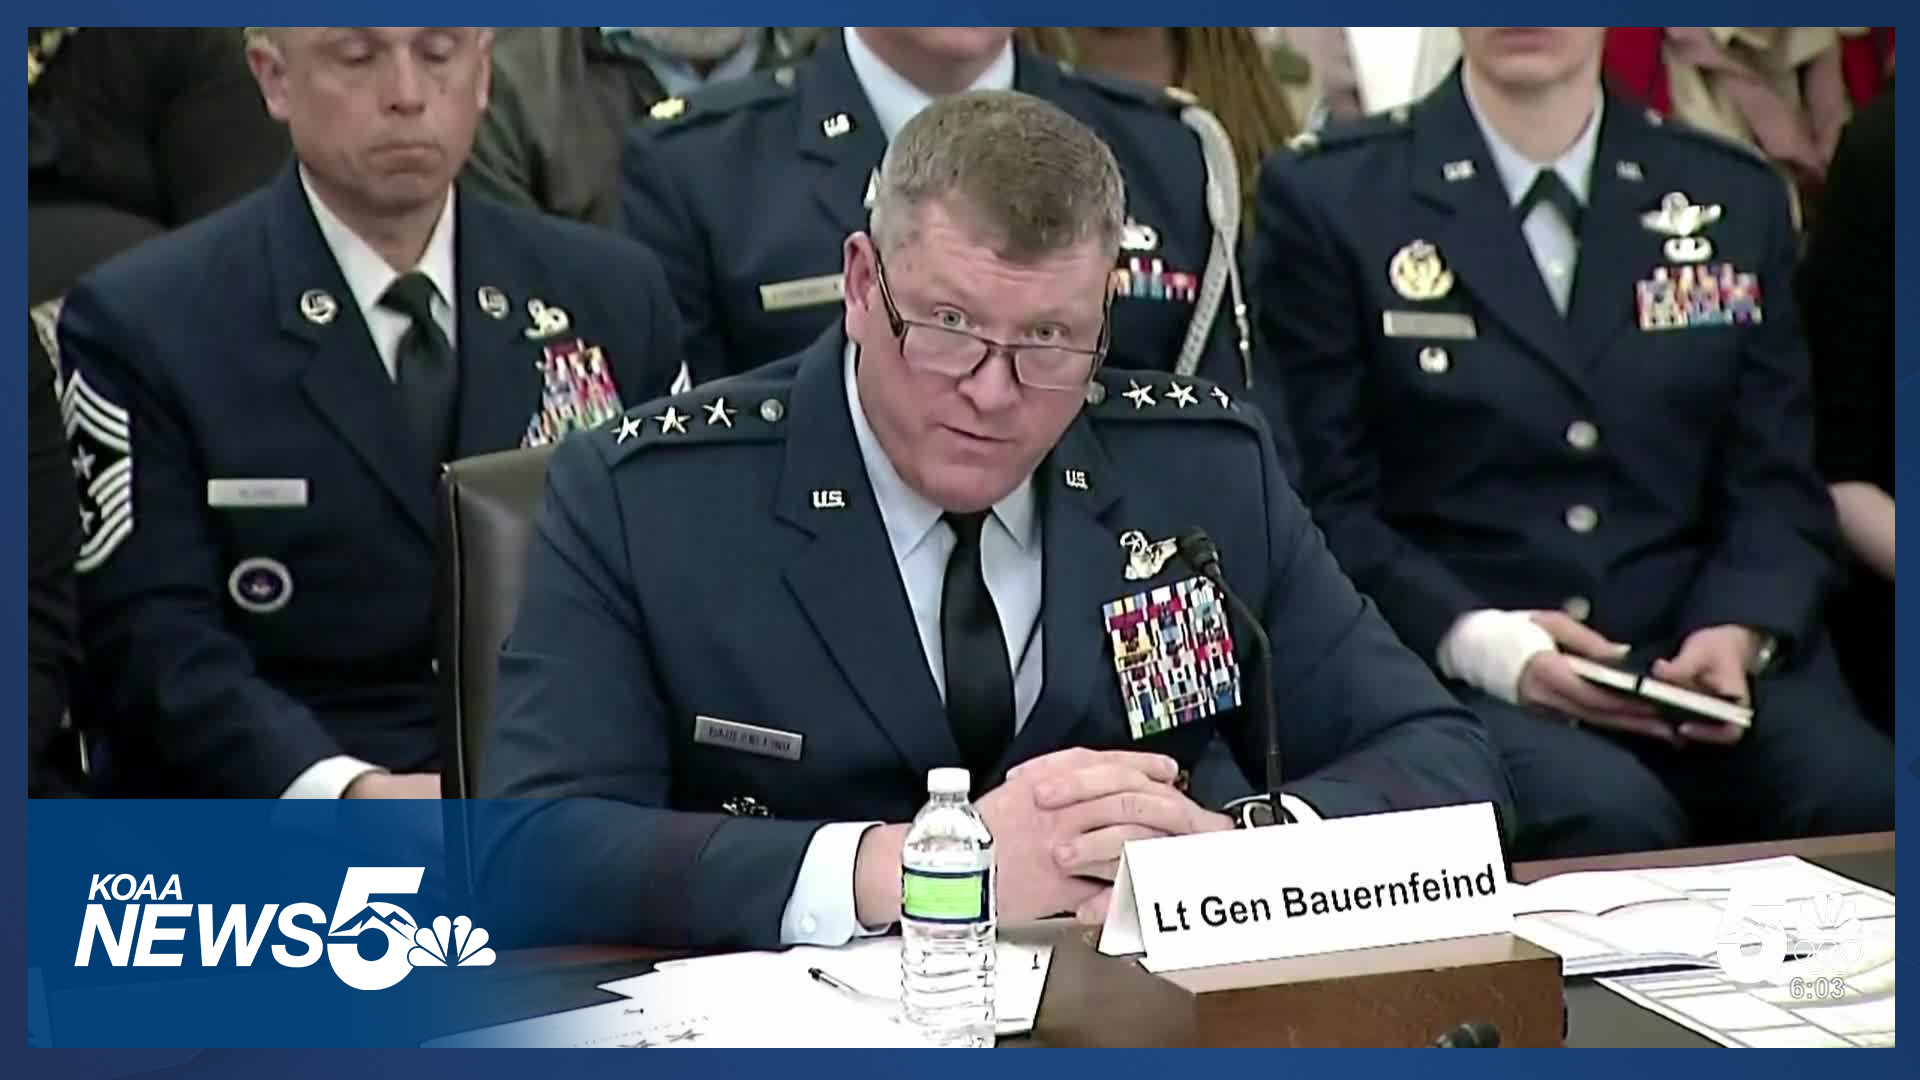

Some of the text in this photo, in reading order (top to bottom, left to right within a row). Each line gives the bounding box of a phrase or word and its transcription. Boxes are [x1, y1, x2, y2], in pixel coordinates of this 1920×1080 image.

[1154, 864, 1497, 932] Lt Gen Bauernfeind
